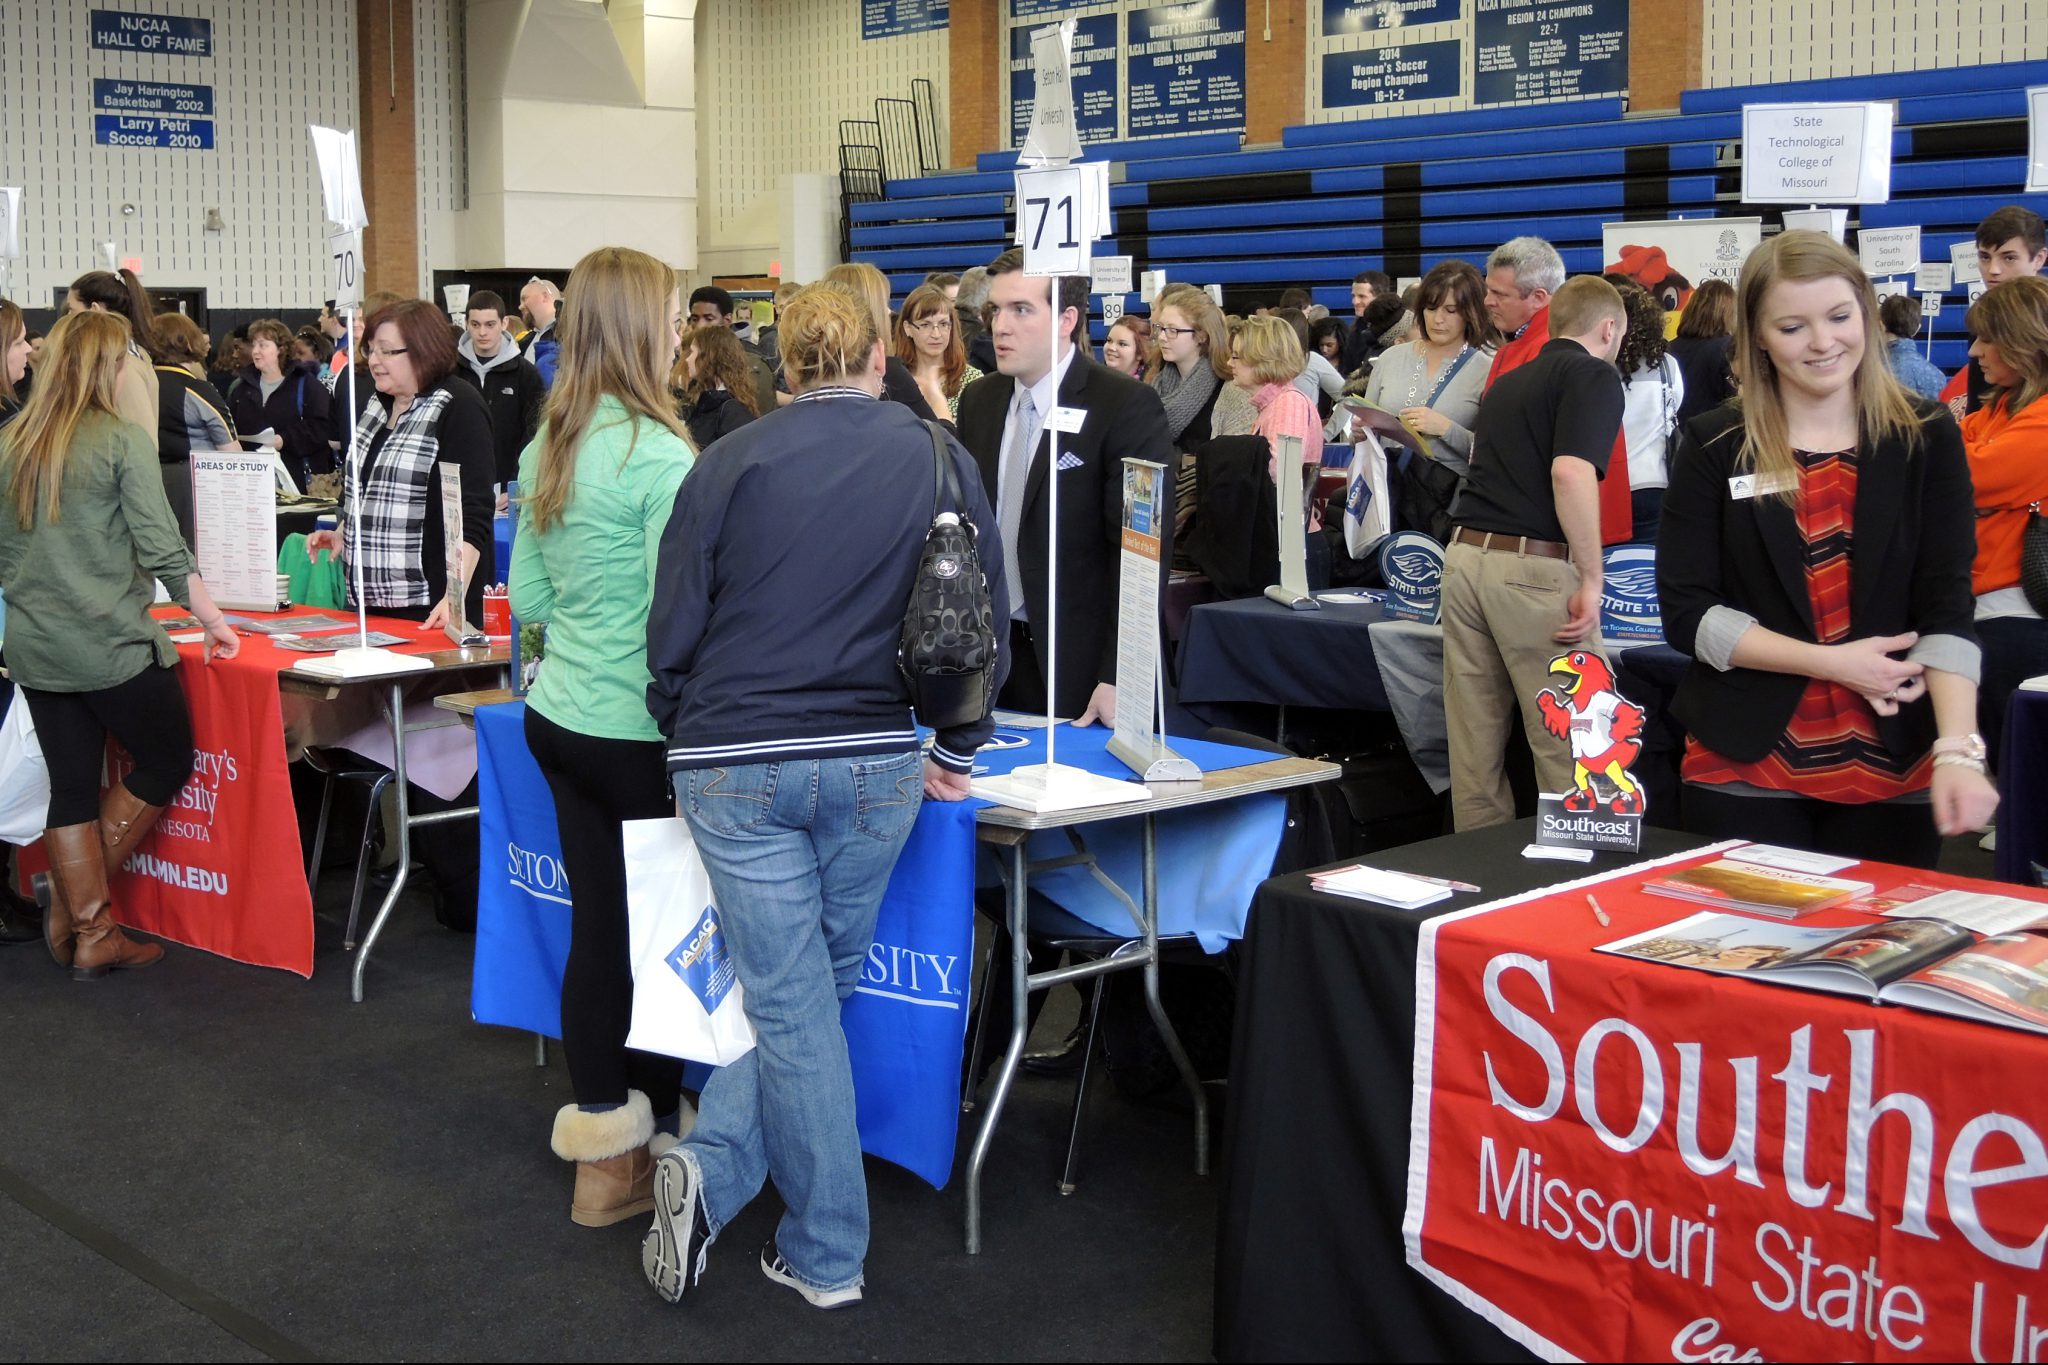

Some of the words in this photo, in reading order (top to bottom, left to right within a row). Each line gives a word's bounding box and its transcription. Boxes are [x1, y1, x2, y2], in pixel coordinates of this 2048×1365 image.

[1345, 7, 1373, 19] Region
[1376, 4, 1387, 15] 24
[1390, 0, 1436, 12] Champions
[1507, 13, 1534, 25] REGION
[1537, 10, 1546, 22] 24
[1549, 4, 1593, 20] CHAMPIONS
[120, 17, 170, 33] NJCAA
[1149, 23, 1179, 38] WOMEN'S
[1181, 17, 1220, 35] BASKETBALL
[1541, 23, 1559, 36] 22-7
[97, 31, 135, 47] HALL
[141, 34, 161, 48] OF
[167, 37, 205, 52] FAME
[1146, 39, 1172, 54] NATIONAL
[1172, 35, 1208, 51] TOURNAMENT
[1209, 30, 1244, 47] PARTICIPANT
[1605, 44, 1620, 52] Smith
[1153, 55, 1173, 67] REGION
[1175, 54, 1182, 64] 24
[1184, 49, 1216, 63] CHAMPIONS
[1379, 47, 1400, 61] 2014
[1352, 63, 1392, 77] Women's
[1395, 60, 1427, 73] Soccer
[1529, 72, 1544, 81] Coach
[1042, 69, 1055, 87] Seton
[1351, 77, 1381, 91] Region
[1385, 73, 1428, 87] Champion
[1529, 81, 1544, 89] Coach
[114, 84, 133, 95] Jay
[138, 84, 194, 99] Harrington
[1374, 89, 1404, 103] 16-1-2
[1529, 90, 1544, 98] Coach
[104, 95, 161, 108] Basketball
[176, 100, 204, 111] 2002
[120, 116, 154, 132] Larry
[160, 119, 190, 132] Petri
[1041, 105, 1065, 128] University
[1793, 116, 1823, 127] State
[109, 131, 158, 146] Soccer
[169, 134, 201, 148] 2010
[1768, 136, 1844, 149] Technological
[1778, 157, 1819, 169] College
[1821, 156, 1834, 167] of
[1782, 177, 1828, 188] Missouri
[1026, 196, 1079, 250] 71
[1866, 234, 1904, 243] University
[1905, 233, 1913, 241] of
[1879, 247, 1901, 255] South
[333, 250, 354, 291] 70
[1875, 259, 1904, 268] Carolina
[1105, 303, 1121, 319] 89
[1922, 299, 1939, 310] 15
[195, 461, 224, 471] AREAS
[226, 462, 238, 471] OF
[240, 463, 269, 472] STUDY
[1389, 574, 1416, 595] STATE
[1598, 593, 1643, 613] STATE
[193, 749, 238, 789] ary's
[155, 819, 210, 842] NESOTA
[1543, 814, 1632, 836] Southeast
[1542, 830, 1574, 840] Missouri
[1575, 832, 1594, 842] State
[1596, 834, 1632, 846] University
[508, 842, 569, 892] SETON
[1743, 866, 1800, 881] SHOW
[1803, 877, 1833, 886] ME
[676, 918, 715, 969] IACAC
[1483, 952, 2048, 1270] Southe
[1478, 1136, 1716, 1287] Missouri
[1752, 1222, 1925, 1351] State
